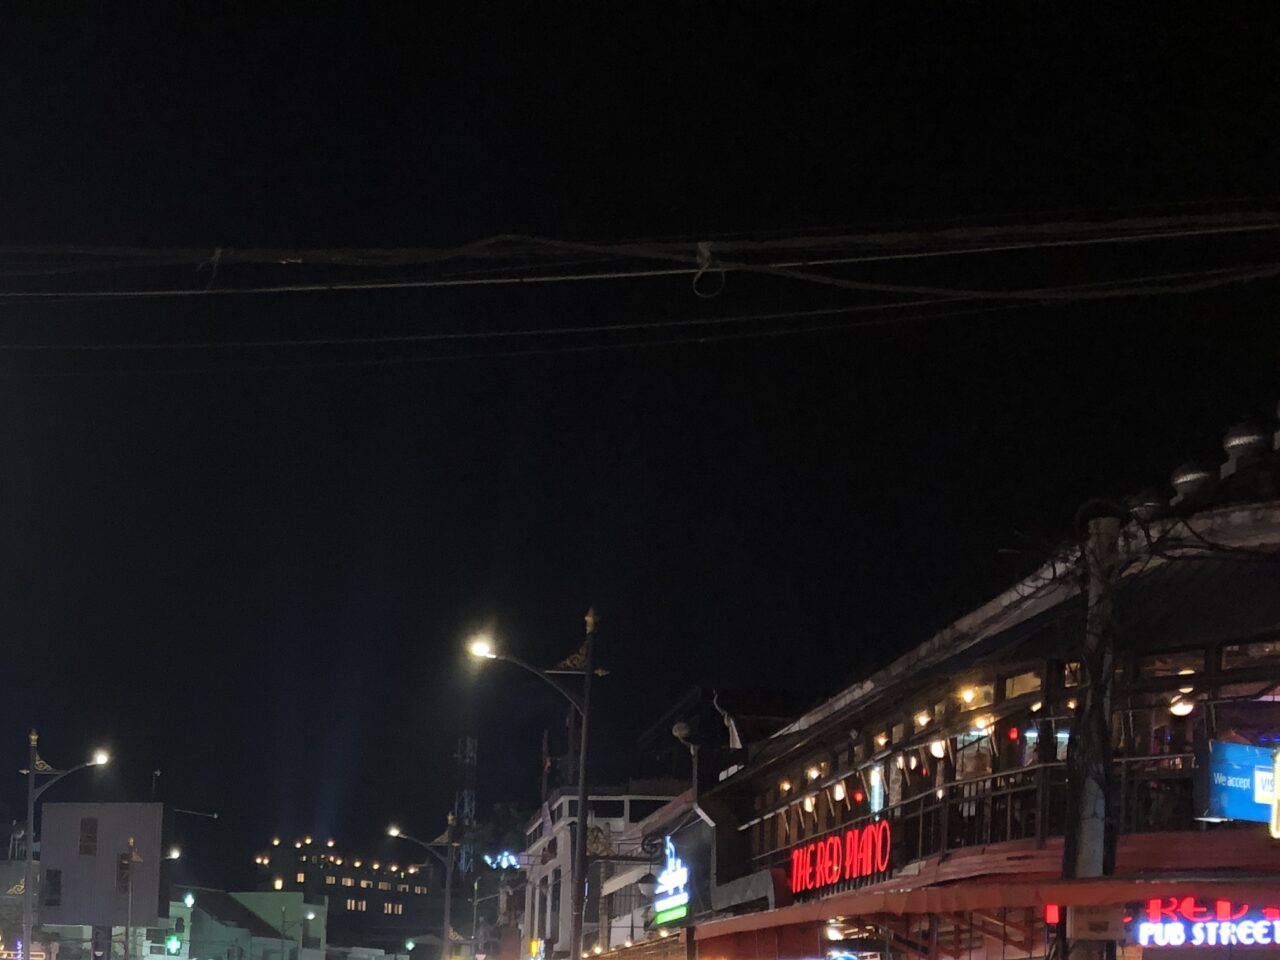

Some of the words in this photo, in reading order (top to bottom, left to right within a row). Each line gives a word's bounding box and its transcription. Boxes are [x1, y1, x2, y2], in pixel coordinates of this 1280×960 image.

[1214, 773, 1227, 786] We
[1227, 776, 1251, 791] accept
[1261, 777, 1274, 792] VIS
[792, 845, 816, 894] THE
[816, 836, 842, 888] RED
[845, 820, 891, 879] PIANO
[1139, 922, 1186, 946] PUB
[1191, 920, 1280, 945] STREET
